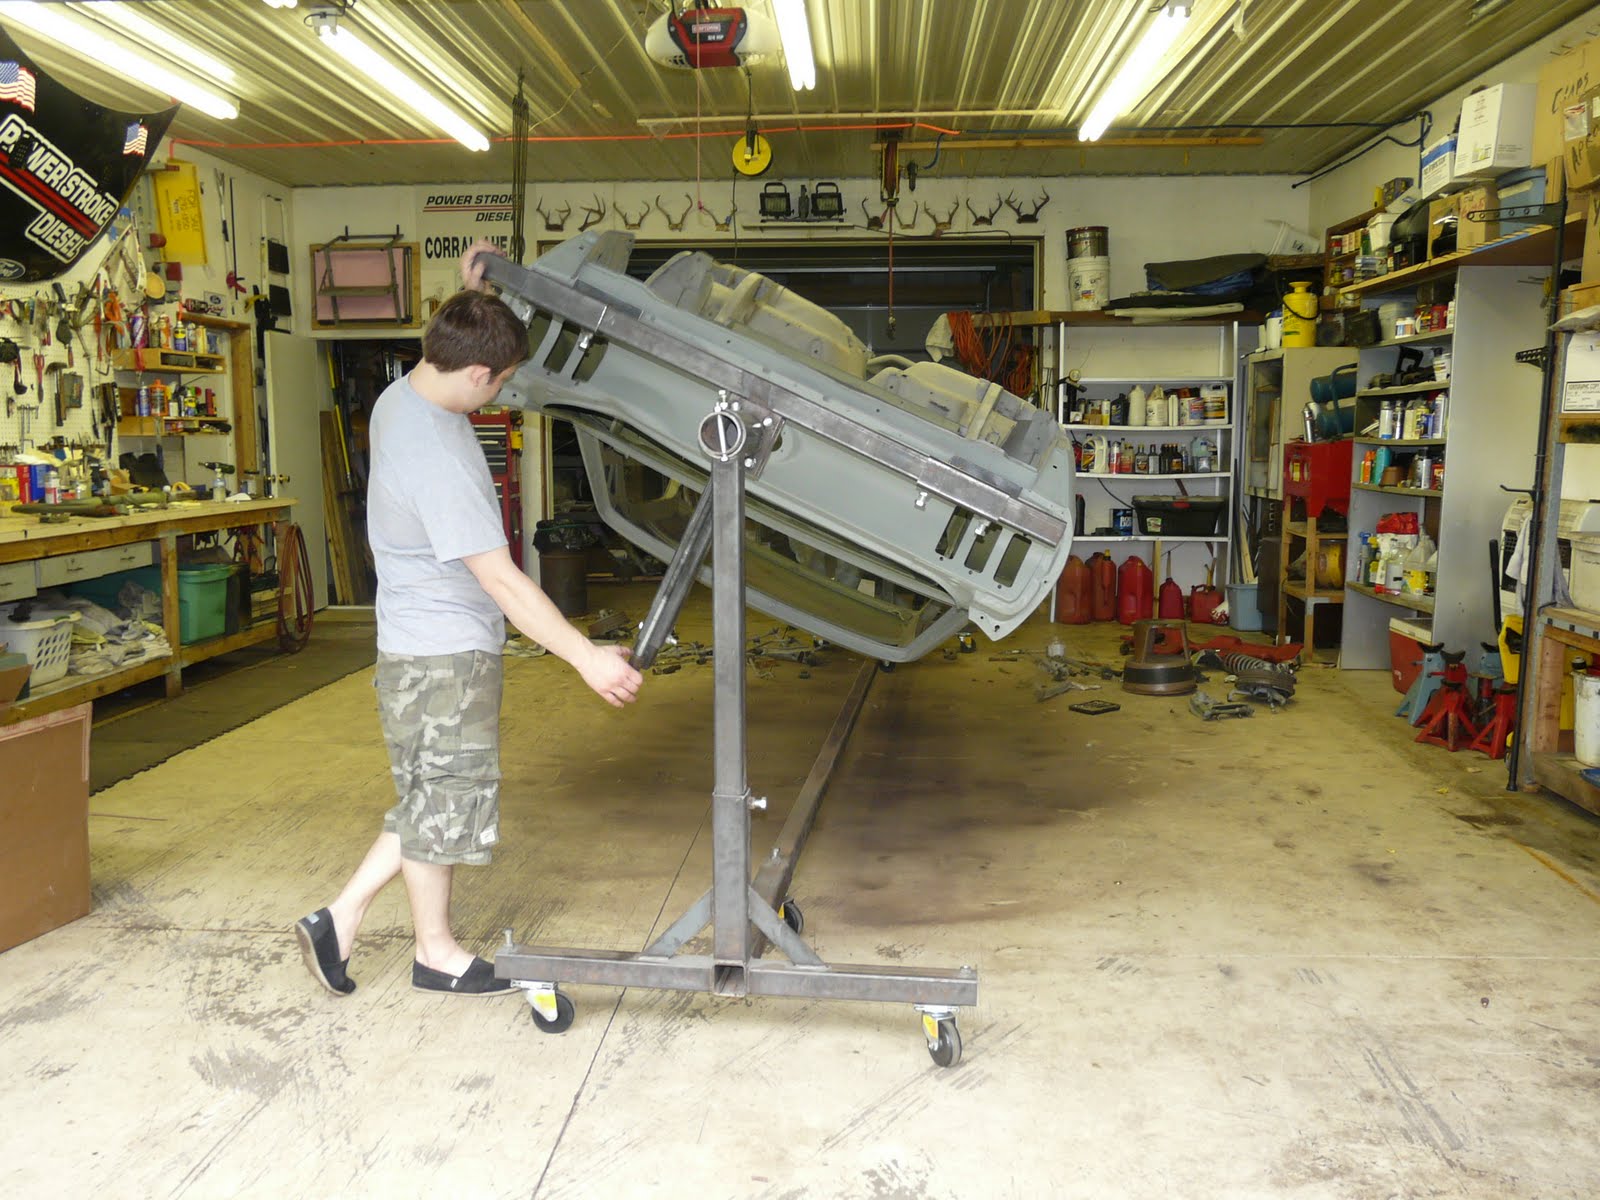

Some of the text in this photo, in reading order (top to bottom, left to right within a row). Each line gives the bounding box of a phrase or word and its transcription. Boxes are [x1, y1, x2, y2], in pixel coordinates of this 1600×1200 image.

[426, 194, 522, 205] POWER STROK
[31, 212, 84, 258] DIESEL
